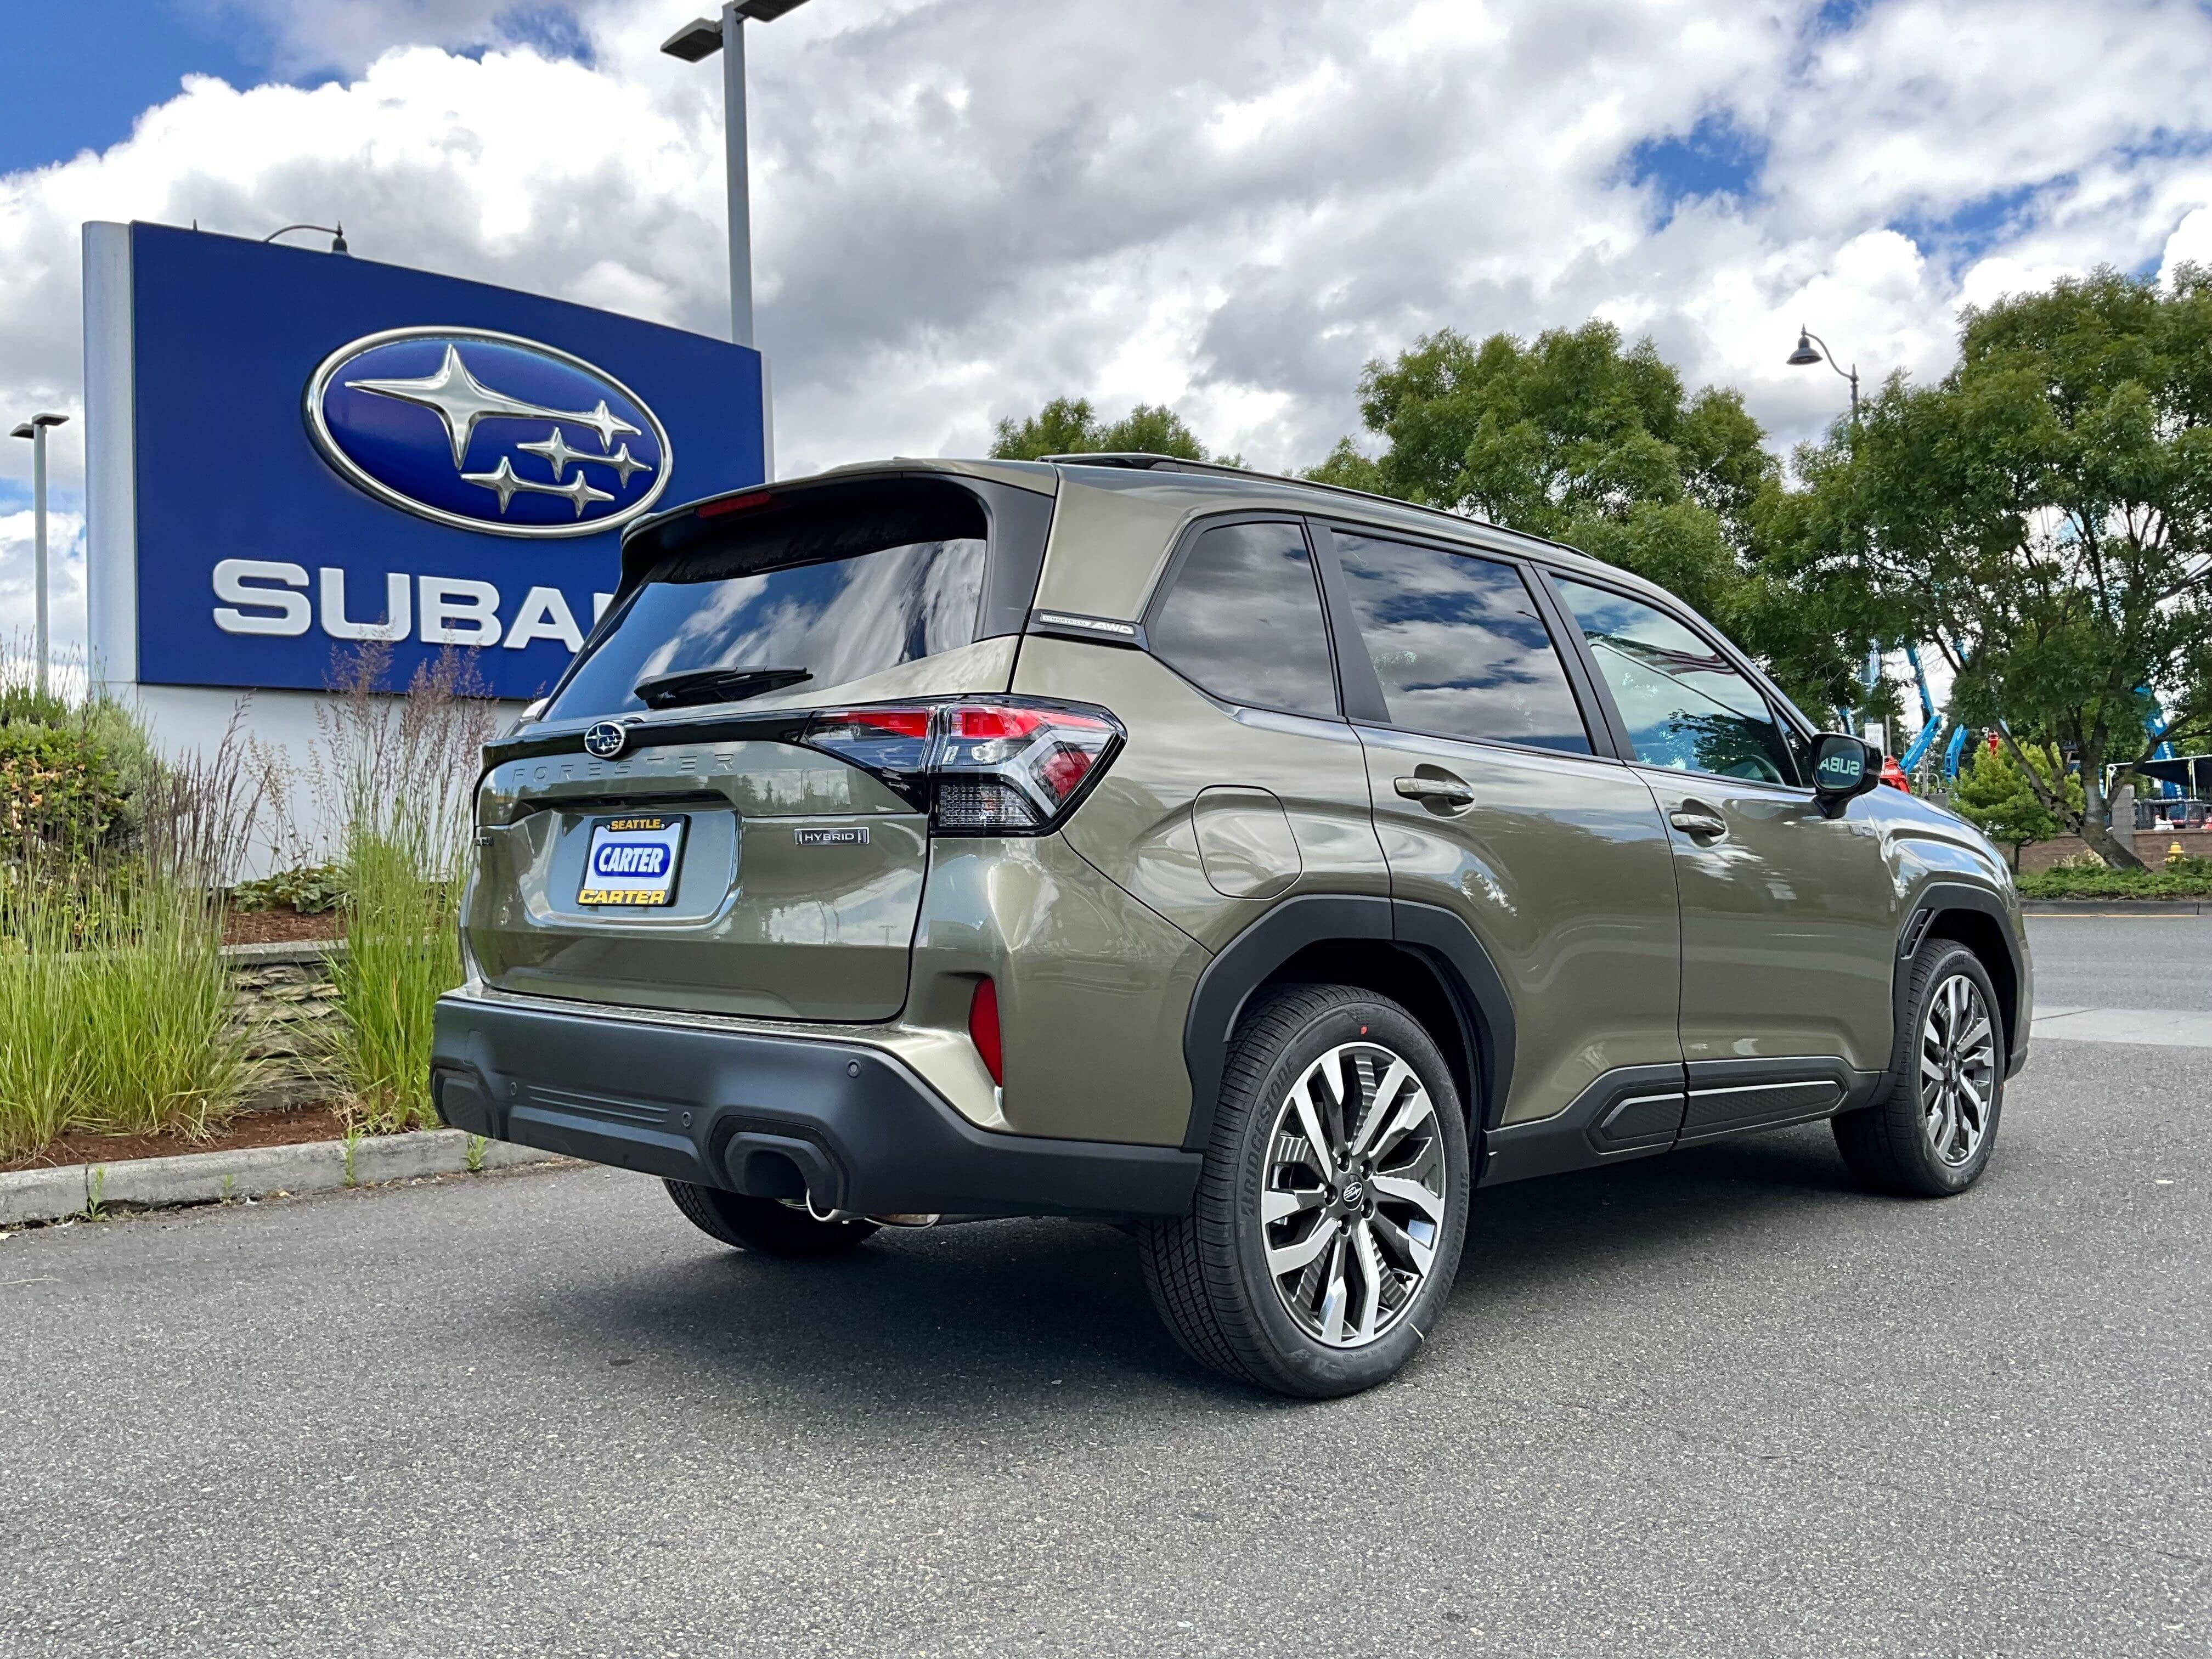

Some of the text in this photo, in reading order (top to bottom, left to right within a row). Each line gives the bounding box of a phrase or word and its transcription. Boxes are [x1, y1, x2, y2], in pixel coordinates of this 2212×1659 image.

[213, 558, 614, 653] SUBA
[1091, 622, 1133, 635] AWD
[511, 753, 735, 783] FORESTER
[611, 819, 661, 830] SEATTLE
[599, 847, 663, 873] CARTER
[578, 889, 665, 904] CARTER
